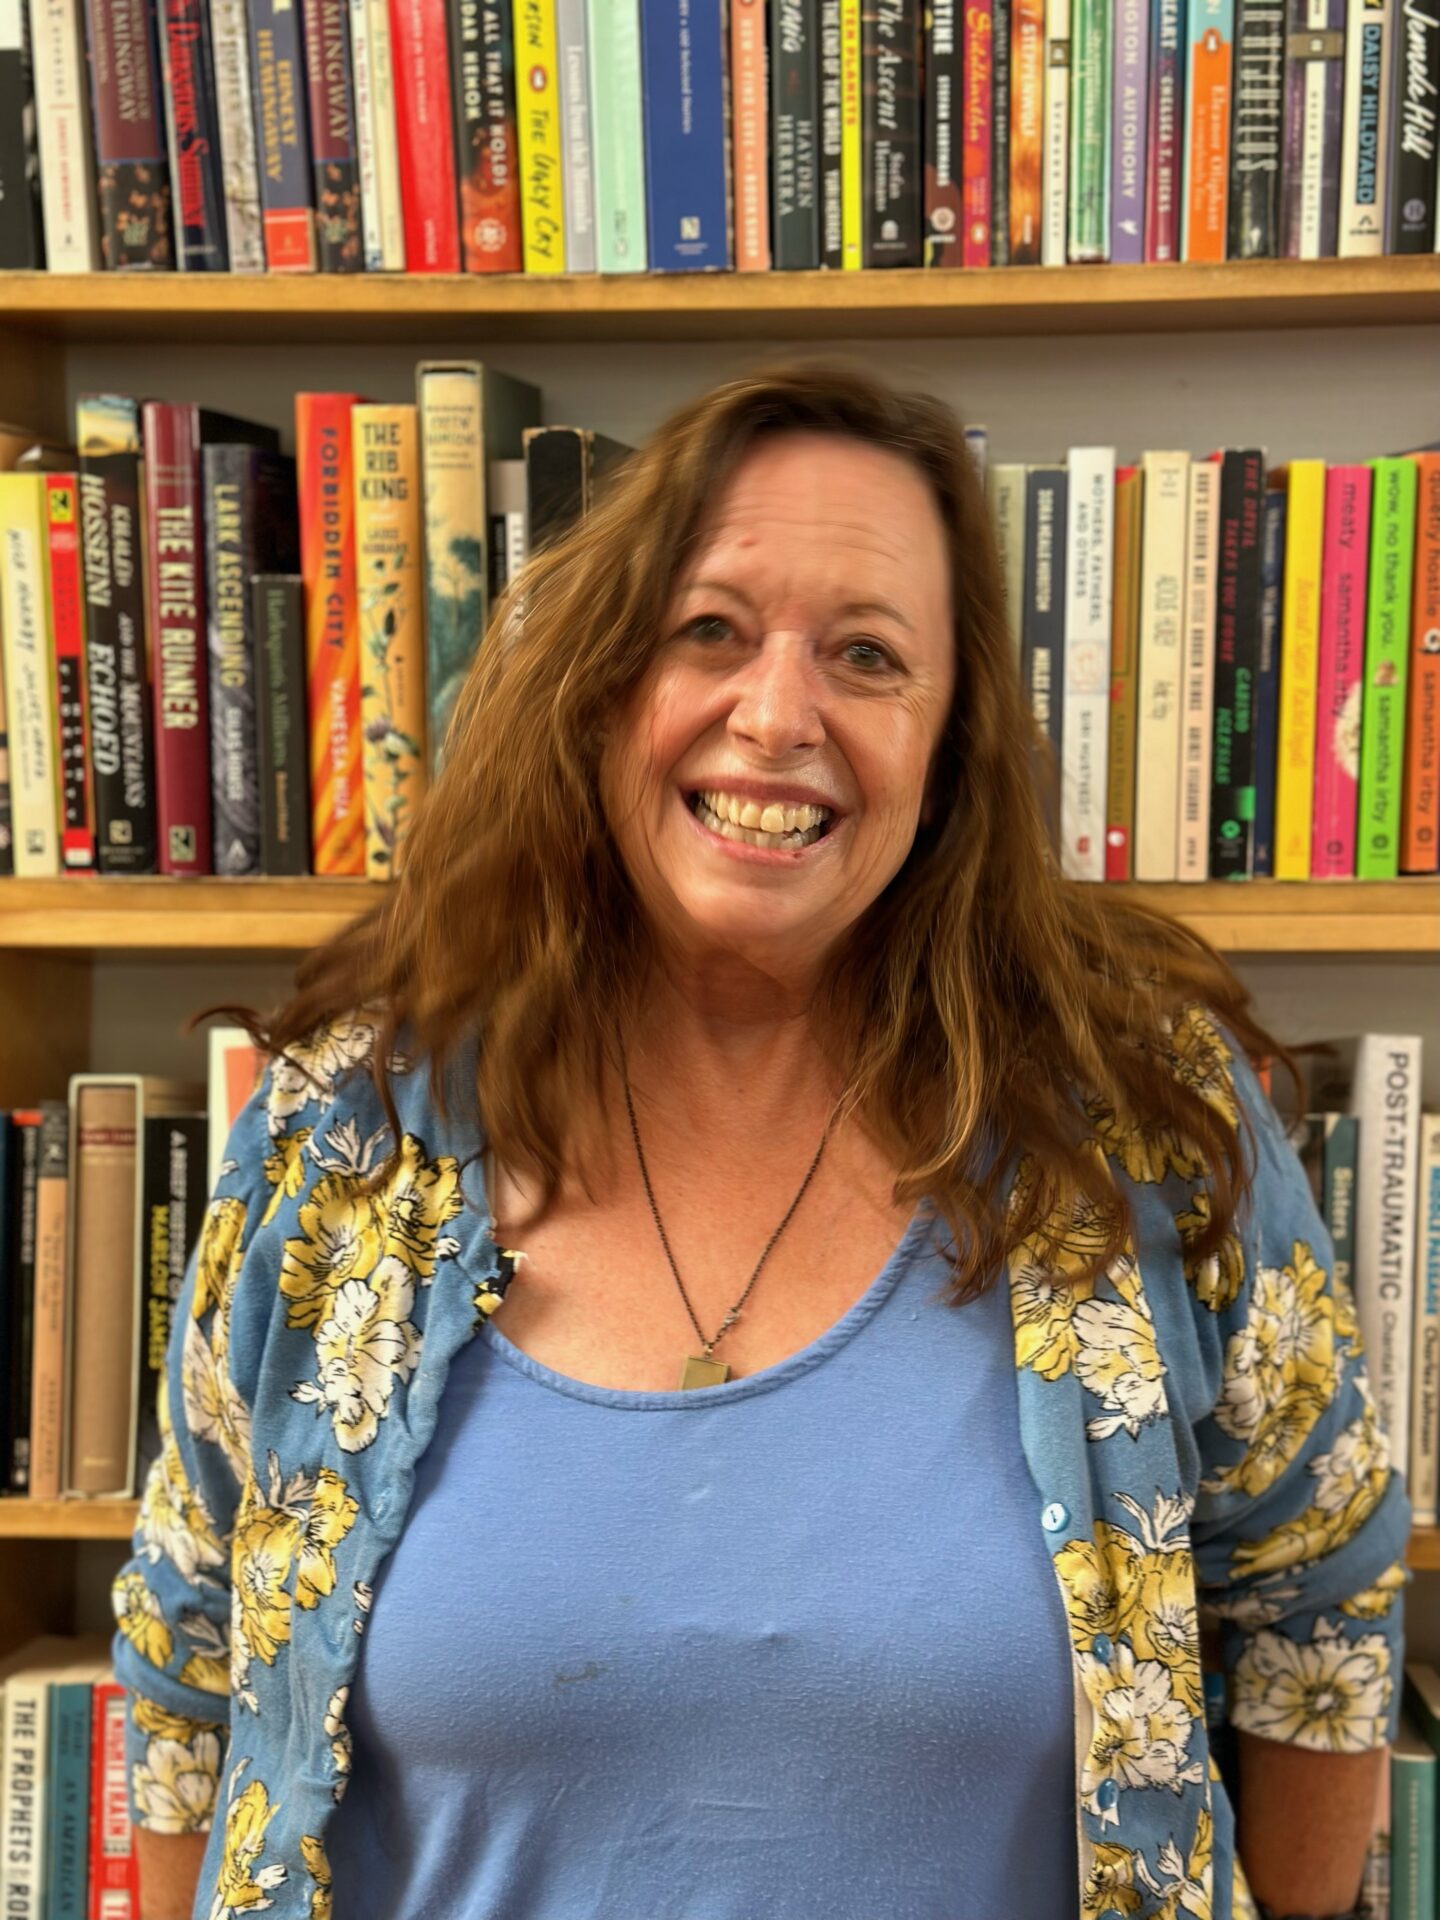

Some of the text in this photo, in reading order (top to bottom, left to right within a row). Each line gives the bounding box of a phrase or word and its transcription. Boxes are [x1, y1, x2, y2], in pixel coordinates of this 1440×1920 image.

[482, 10, 500, 44] ALL
[822, 1, 840, 27] THE
[1362, 25, 1381, 89] DAISY
[256, 30, 282, 182] HEMINGWAY
[276, 59, 297, 147] ERNEST
[485, 51, 503, 95] THAT
[487, 100, 505, 118] IT
[823, 79, 840, 105] THE
[844, 8, 857, 126] TEN PLANETS
[877, 44, 903, 130] Ascent
[966, 7, 991, 142] Siddhartha
[1021, 23, 1037, 138] STEPPENWOLF
[1401, 3, 1439, 159] Jemele Hill
[570, 141, 590, 164] the
[743, 111, 757, 147] LOVE
[777, 115, 794, 217] HERRERA
[796, 120, 813, 209] HAYDEN
[1122, 86, 1137, 200] AUTONOMY
[1356, 94, 1379, 203] HILDYARD
[362, 422, 401, 446] THE
[365, 451, 399, 473] RIB
[213, 484, 242, 544] LARK
[359, 477, 408, 501] KING
[111, 504, 134, 587] KHALED
[1075, 502, 1089, 599] AND OTHERS
[1089, 474, 1104, 626] MOTHERS, FATHERS,
[81, 473, 121, 775] HOSSEINI ECHOED
[157, 506, 202, 729] THE KITE RUNNER
[216, 550, 247, 688] ASCENDING
[321, 428, 350, 820] FORBIDDEN CITY VANESSA HUA
[1330, 483, 1357, 719] meaty samantha irby
[1372, 469, 1402, 823] wow, no thank you. samantha irby
[120, 680, 145, 809] MOUNTAINS
[1422, 671, 1436, 770] samantha
[1418, 775, 1434, 815] irby
[169, 1148, 187, 1199] BRIEF
[170, 1129, 187, 1147] A
[1378, 1051, 1410, 1301] POST-TRAUMATIC
[1333, 1167, 1353, 1239] Sisters
[148, 1205, 169, 1370] MARLON JAMES
[13, 1700, 36, 1739] THE
[10, 1748, 35, 1863] PROPHETS
[109, 1781, 129, 1837] TRAIN
